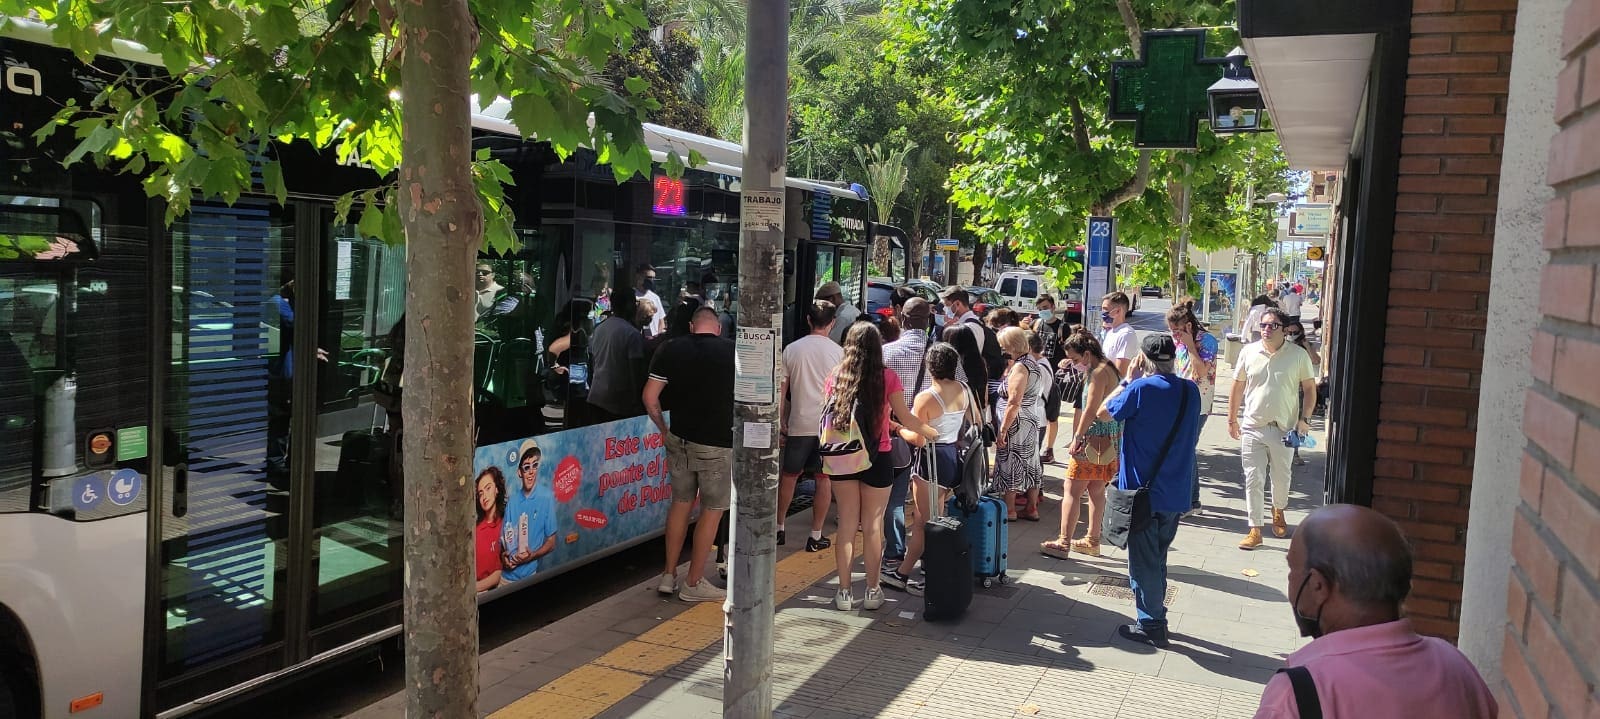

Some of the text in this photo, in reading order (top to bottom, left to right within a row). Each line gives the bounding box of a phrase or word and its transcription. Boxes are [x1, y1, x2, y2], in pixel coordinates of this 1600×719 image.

[0, 66, 42, 96] a
[743, 195, 781, 204] TRABAJO
[840, 216, 865, 231] ENTRADA
[1091, 221, 1110, 237] 23
[744, 332, 771, 341] BUSCA
[605, 435, 640, 460] Este
[599, 462, 645, 497] ponte
[647, 453, 661, 477] el
[617, 489, 638, 515] de
